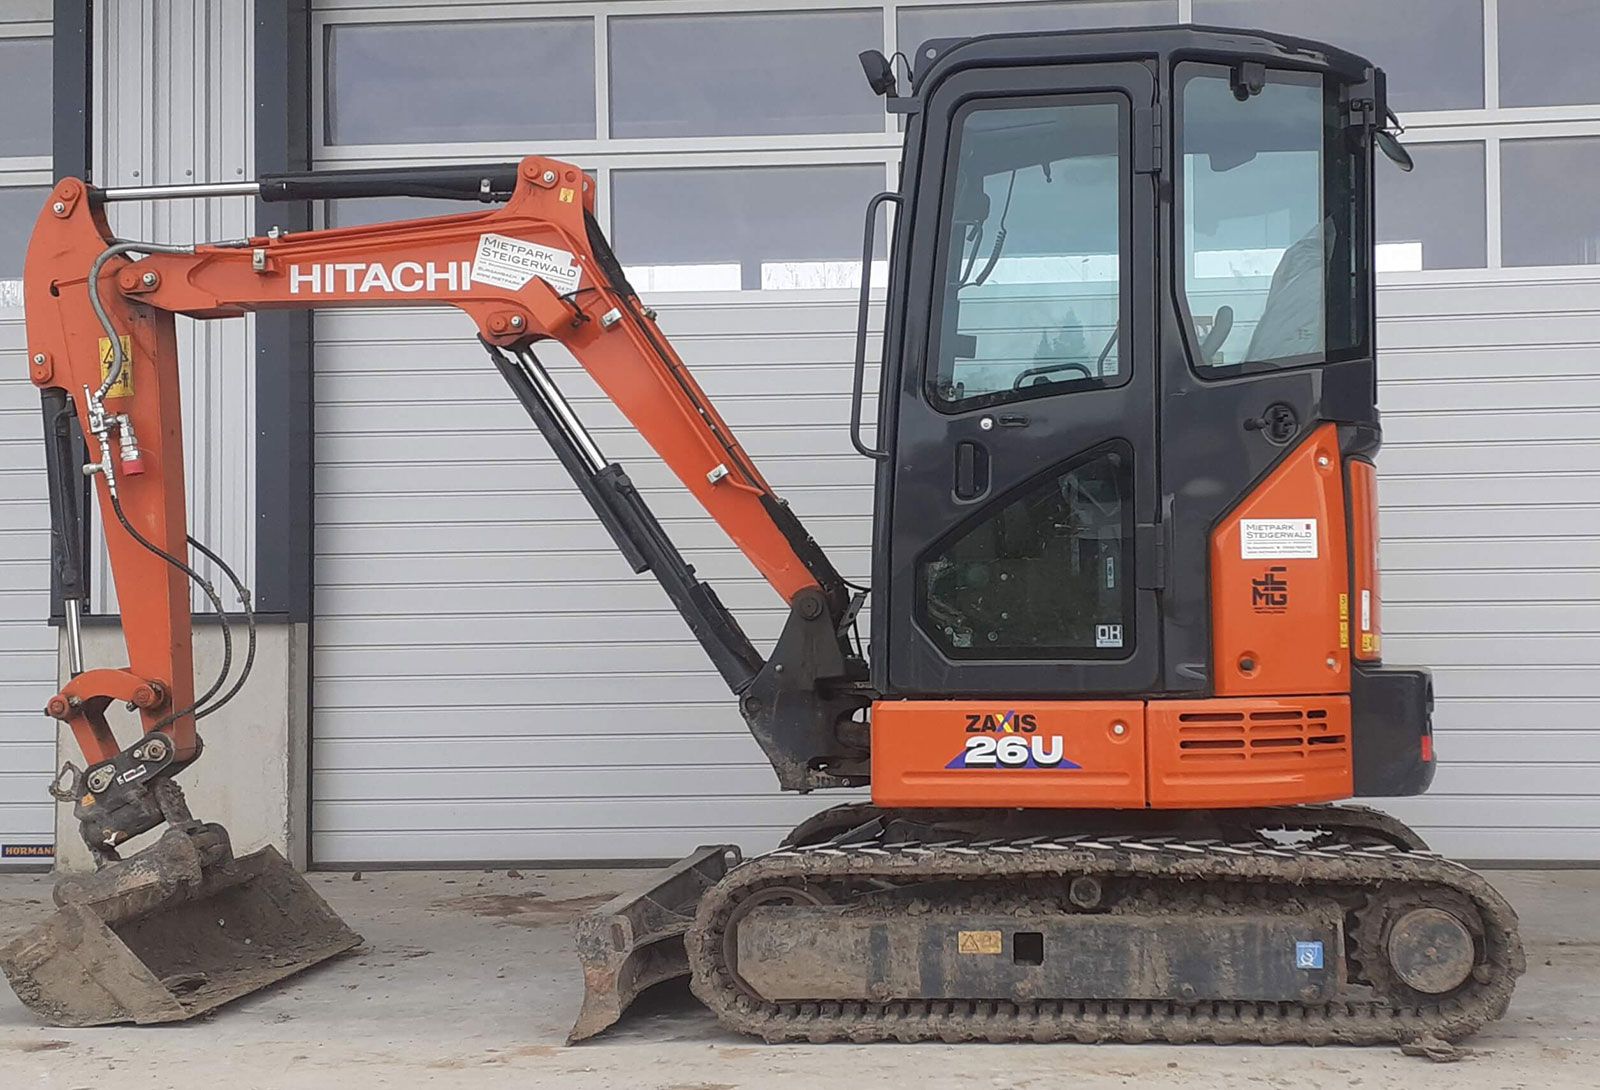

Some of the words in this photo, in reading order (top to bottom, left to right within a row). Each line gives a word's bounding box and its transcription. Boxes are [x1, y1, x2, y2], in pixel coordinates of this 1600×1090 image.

[481, 247, 577, 278] STEIGERWALD
[484, 237, 553, 261] MIETPARK
[290, 261, 471, 294] HITACHI
[1246, 531, 1312, 539] STEIGERWALD
[965, 710, 1037, 733] ZAXIS
[964, 735, 1064, 768] 26U
